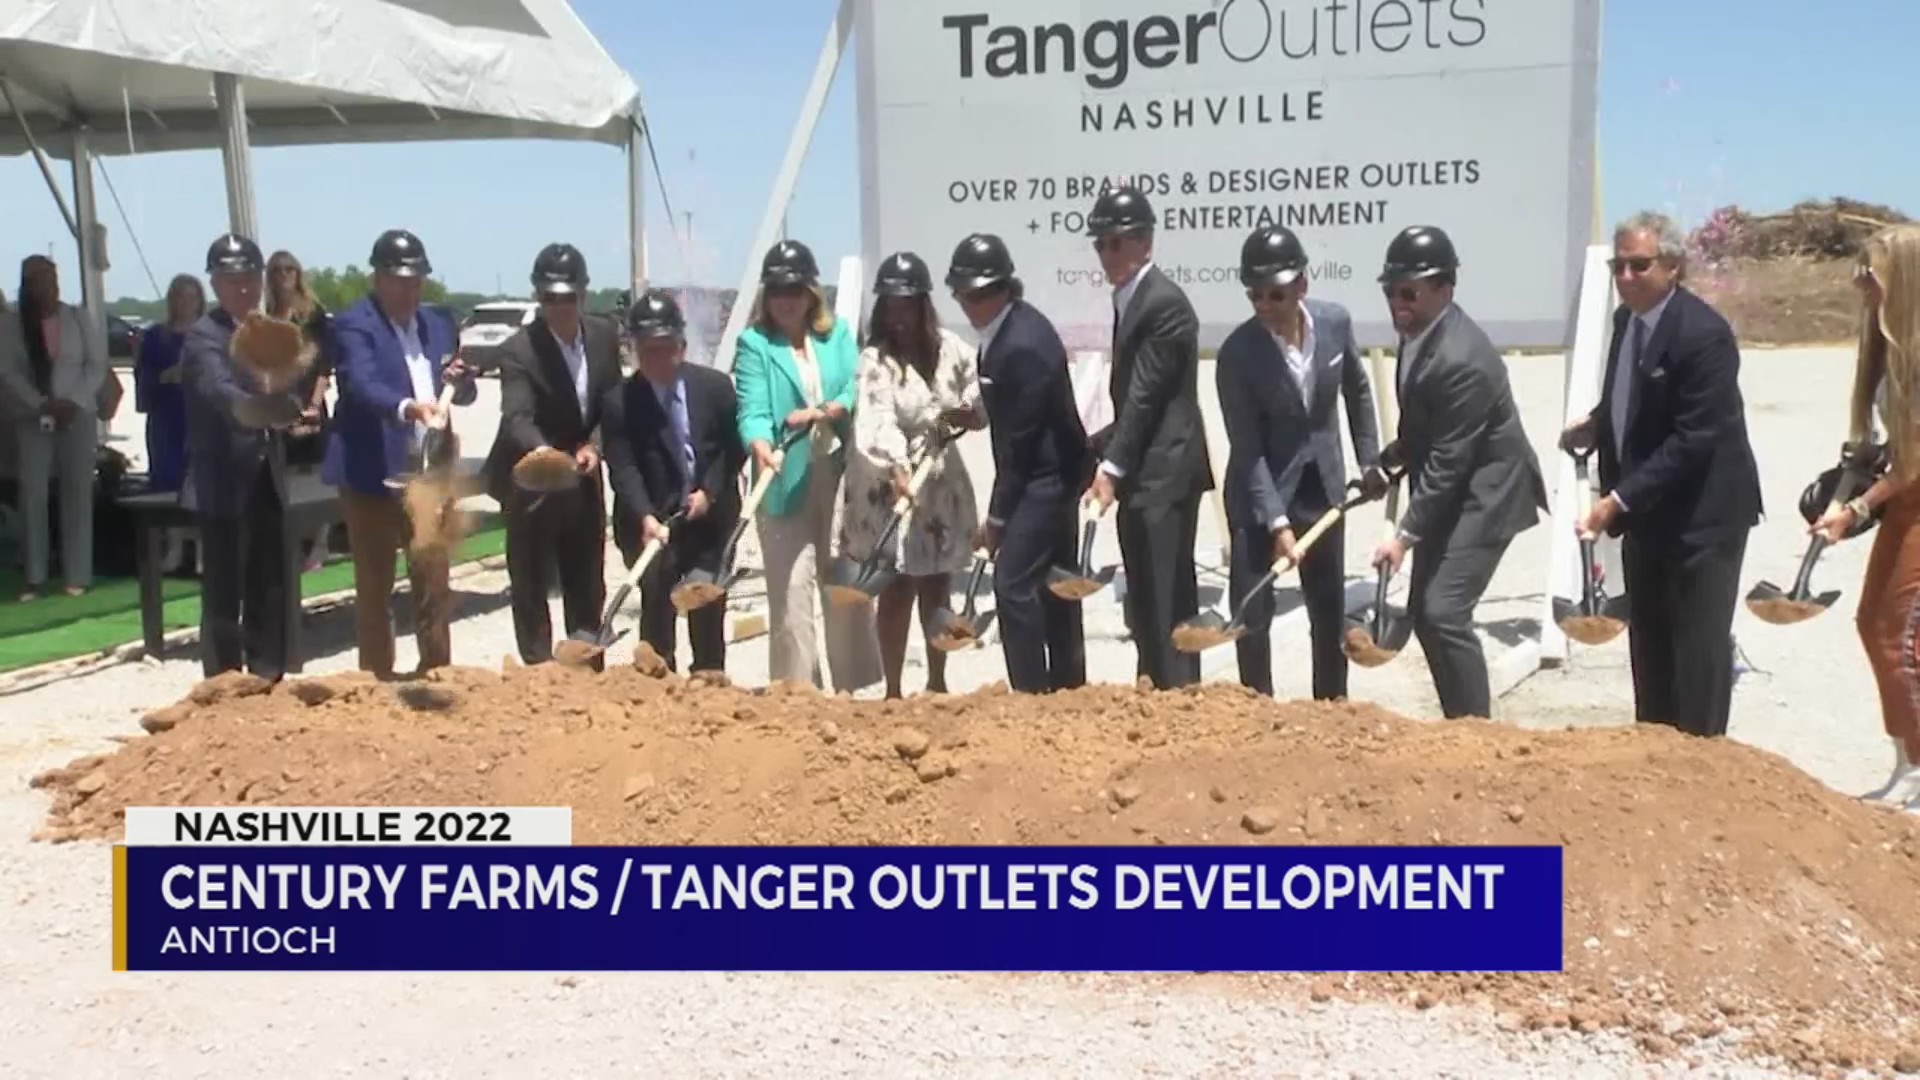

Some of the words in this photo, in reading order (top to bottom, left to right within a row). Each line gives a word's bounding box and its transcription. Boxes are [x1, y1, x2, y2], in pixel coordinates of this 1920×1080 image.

[1081, 91, 1324, 132] NASHVILLE
[949, 180, 1018, 203] OVER
[1028, 177, 1056, 201] 70
[1180, 171, 1198, 195] &
[1208, 165, 1351, 194] DESIGNER
[1361, 159, 1481, 188] OUTLETS
[1163, 200, 1388, 230] ENTERTAINMENT
